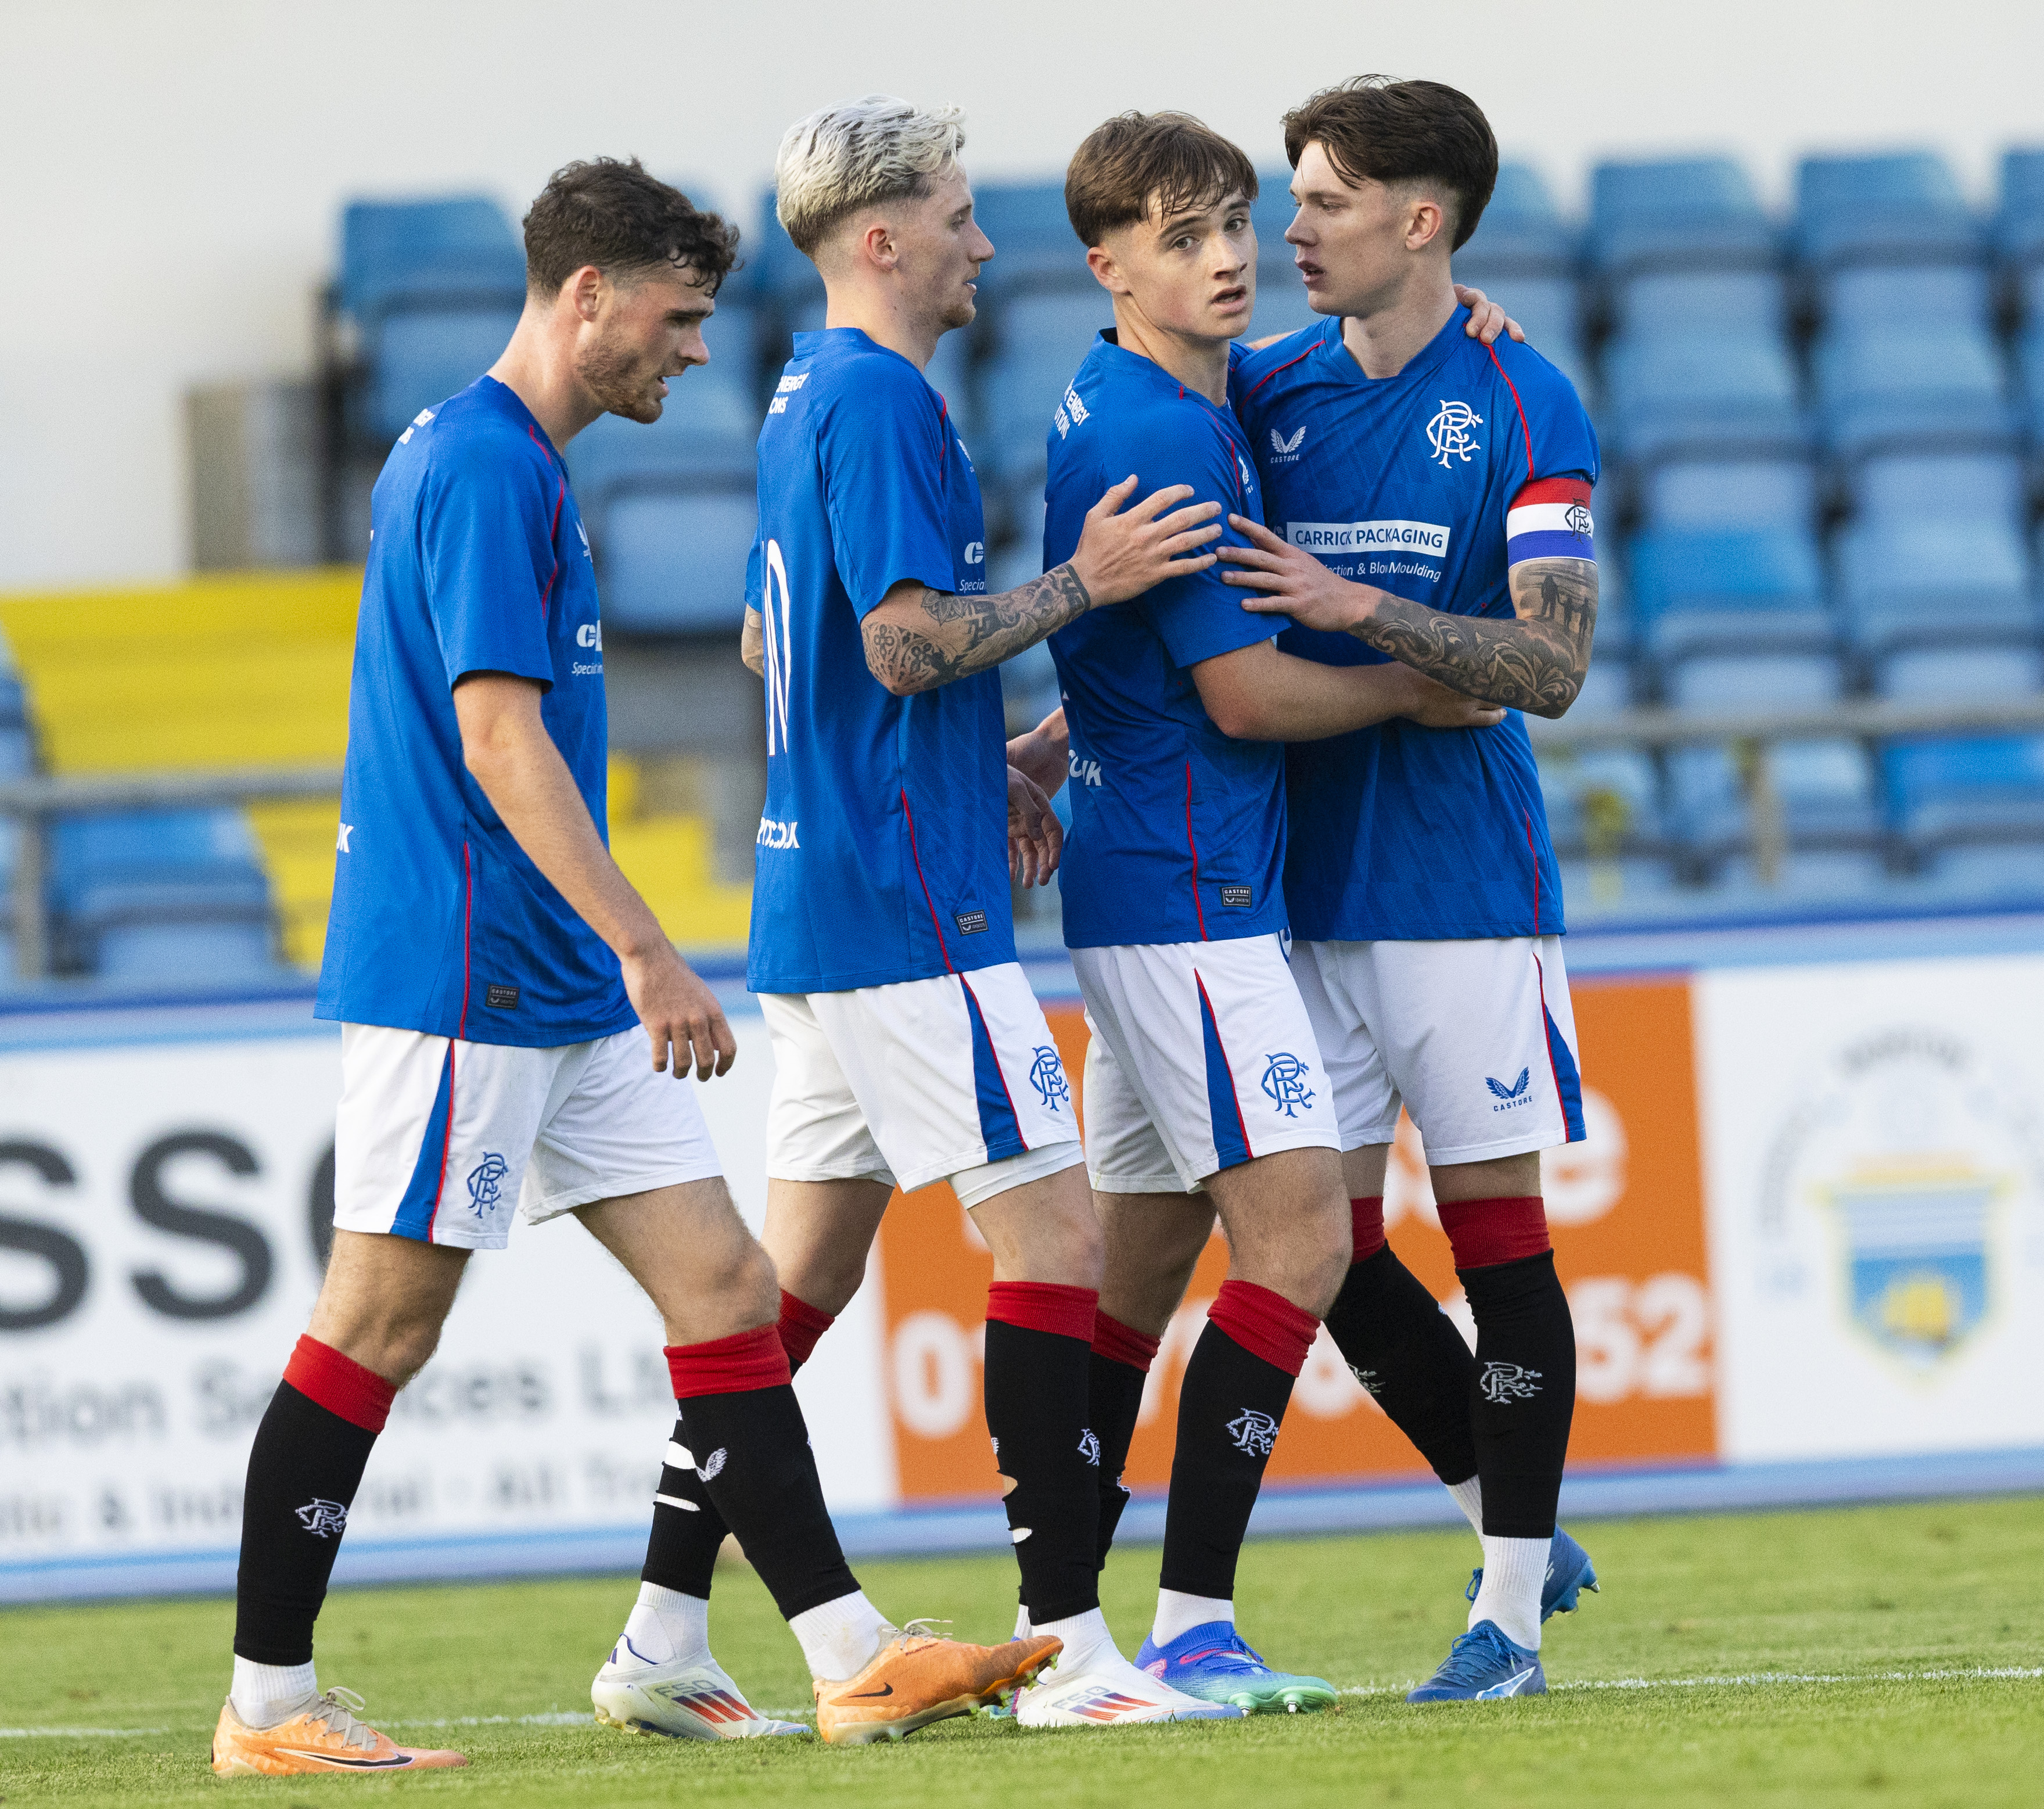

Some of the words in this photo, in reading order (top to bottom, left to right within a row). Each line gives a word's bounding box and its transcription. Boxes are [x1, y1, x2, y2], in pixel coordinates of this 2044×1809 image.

[1270, 454, 1300, 464] CASTORE
[1295, 530, 1352, 545] CARRICK
[1356, 528, 1443, 548] PACKAGING
[1357, 563, 1366, 575] &
[1389, 562, 1441, 582] Moulding
[1493, 1095, 1533, 1112] CASTORE
